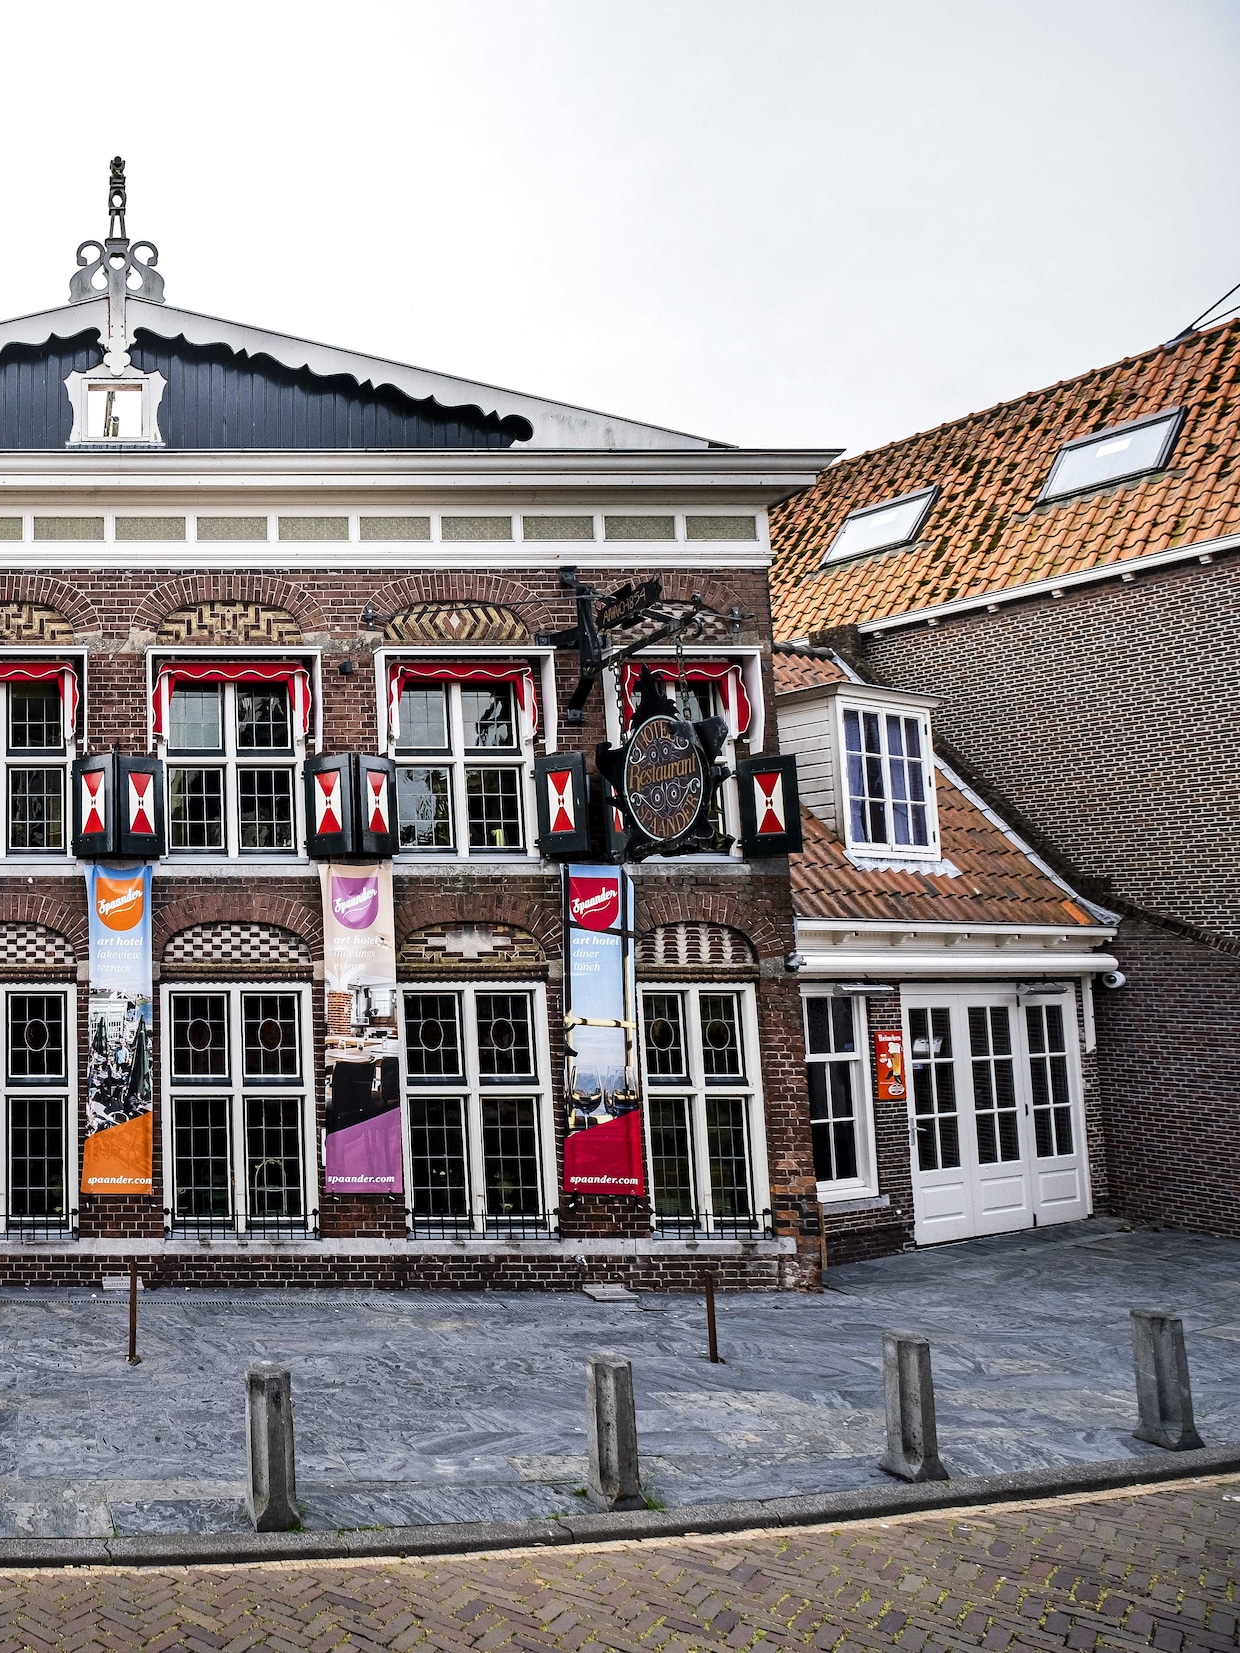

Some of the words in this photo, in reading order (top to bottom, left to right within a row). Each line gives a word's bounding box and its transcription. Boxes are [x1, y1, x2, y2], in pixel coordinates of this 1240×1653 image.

[629, 753, 696, 792] Restaurant
[636, 794, 698, 837] SPAANDER
[98, 888, 143, 915] Spaander
[333, 886, 378, 914] Spaander
[571, 886, 618, 914] Spaander
[96, 937, 114, 946] art
[116, 936, 144, 946] hotel
[333, 936, 351, 945] art
[353, 936, 380, 945] hotel
[572, 936, 590, 945] art
[592, 935, 620, 946] hotel
[96, 949, 142, 959] lakeview
[333, 949, 376, 960] meetings
[572, 948, 600, 959] diner
[96, 962, 132, 973] terrace
[333, 962, 366, 972] events
[572, 961, 601, 972] lunch
[327, 1174, 395, 1184] spaander.com
[569, 1174, 639, 1185] spaander.com
